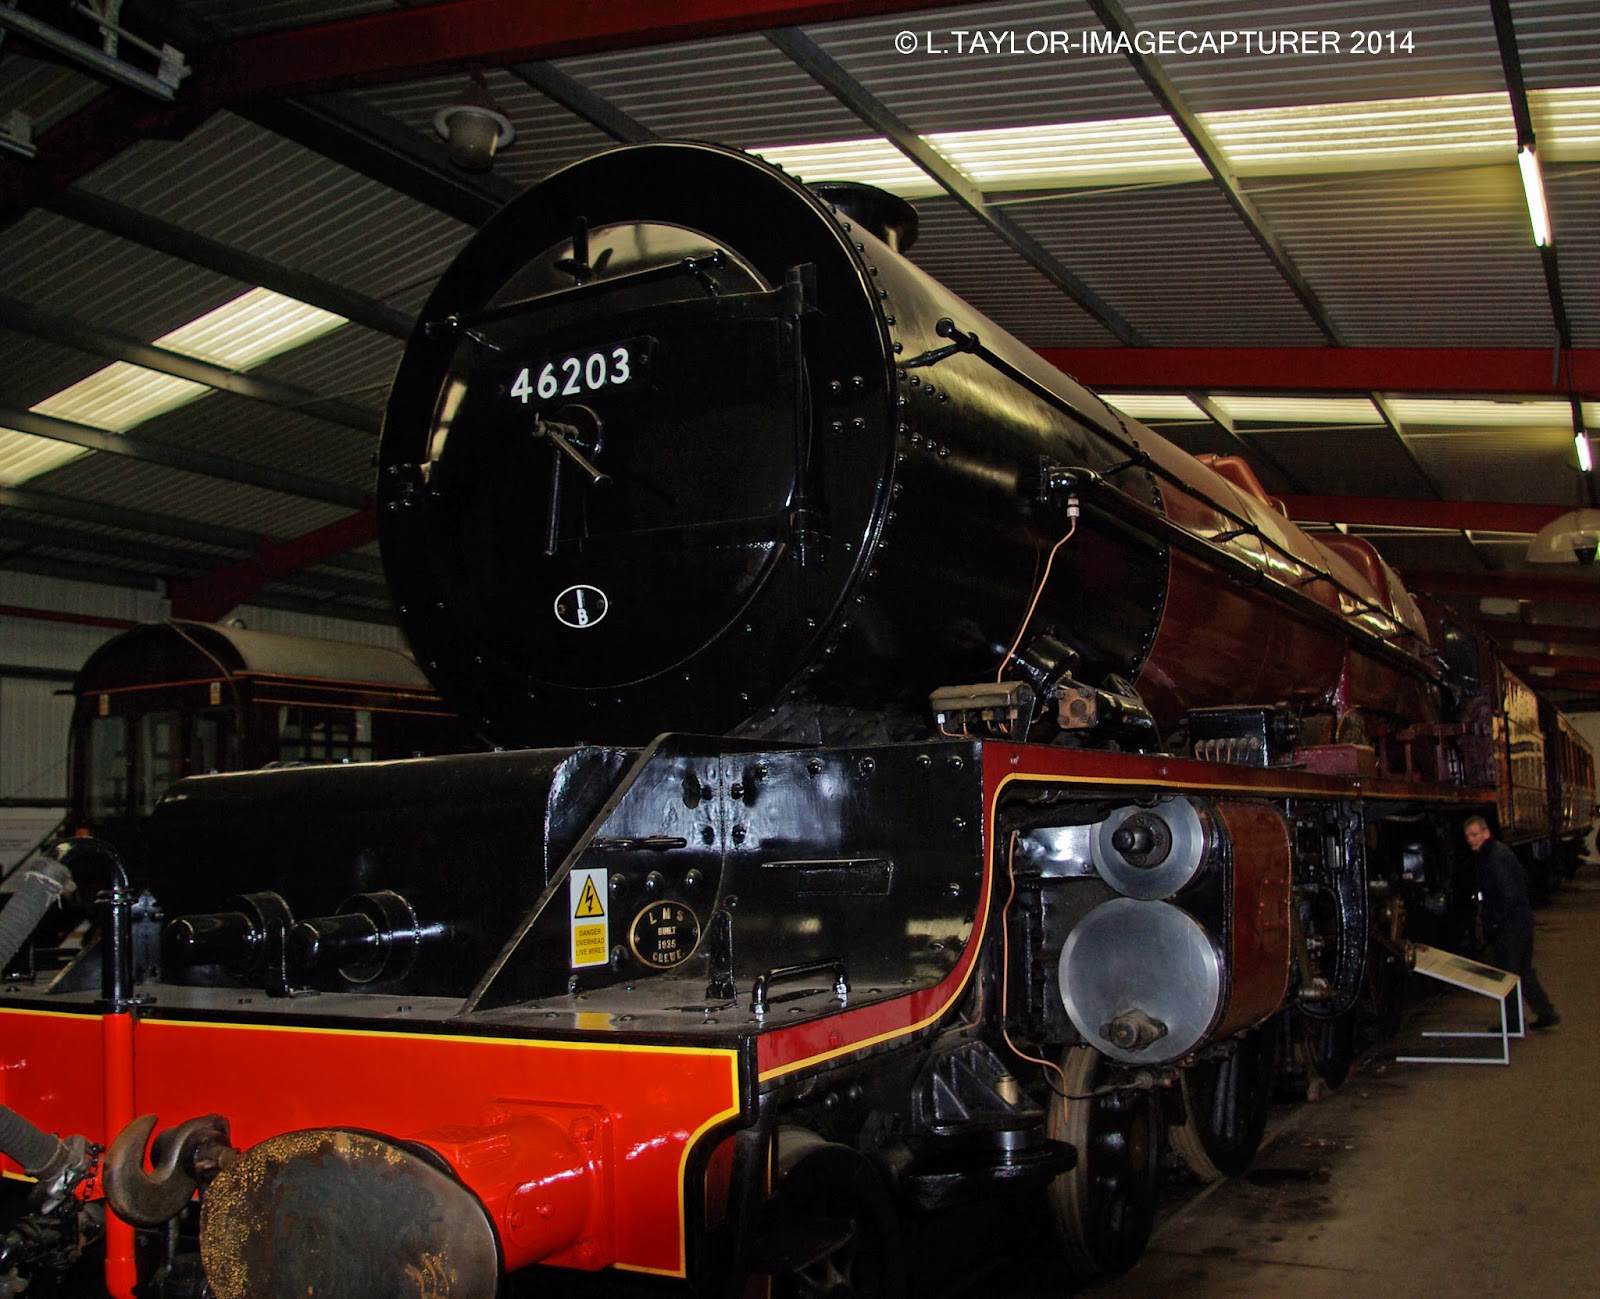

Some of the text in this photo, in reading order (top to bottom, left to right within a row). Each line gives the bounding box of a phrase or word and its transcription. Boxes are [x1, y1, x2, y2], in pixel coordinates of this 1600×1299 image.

[510, 347, 630, 404] 46203
[579, 927, 601, 937] DANGER
[657, 926, 677, 936] BUILT
[575, 937, 605, 947] OVERHEAD
[657, 939, 677, 950] 1935
[575, 946, 605, 956] LIVE WIRES
[652, 949, 683, 963] CREWE
